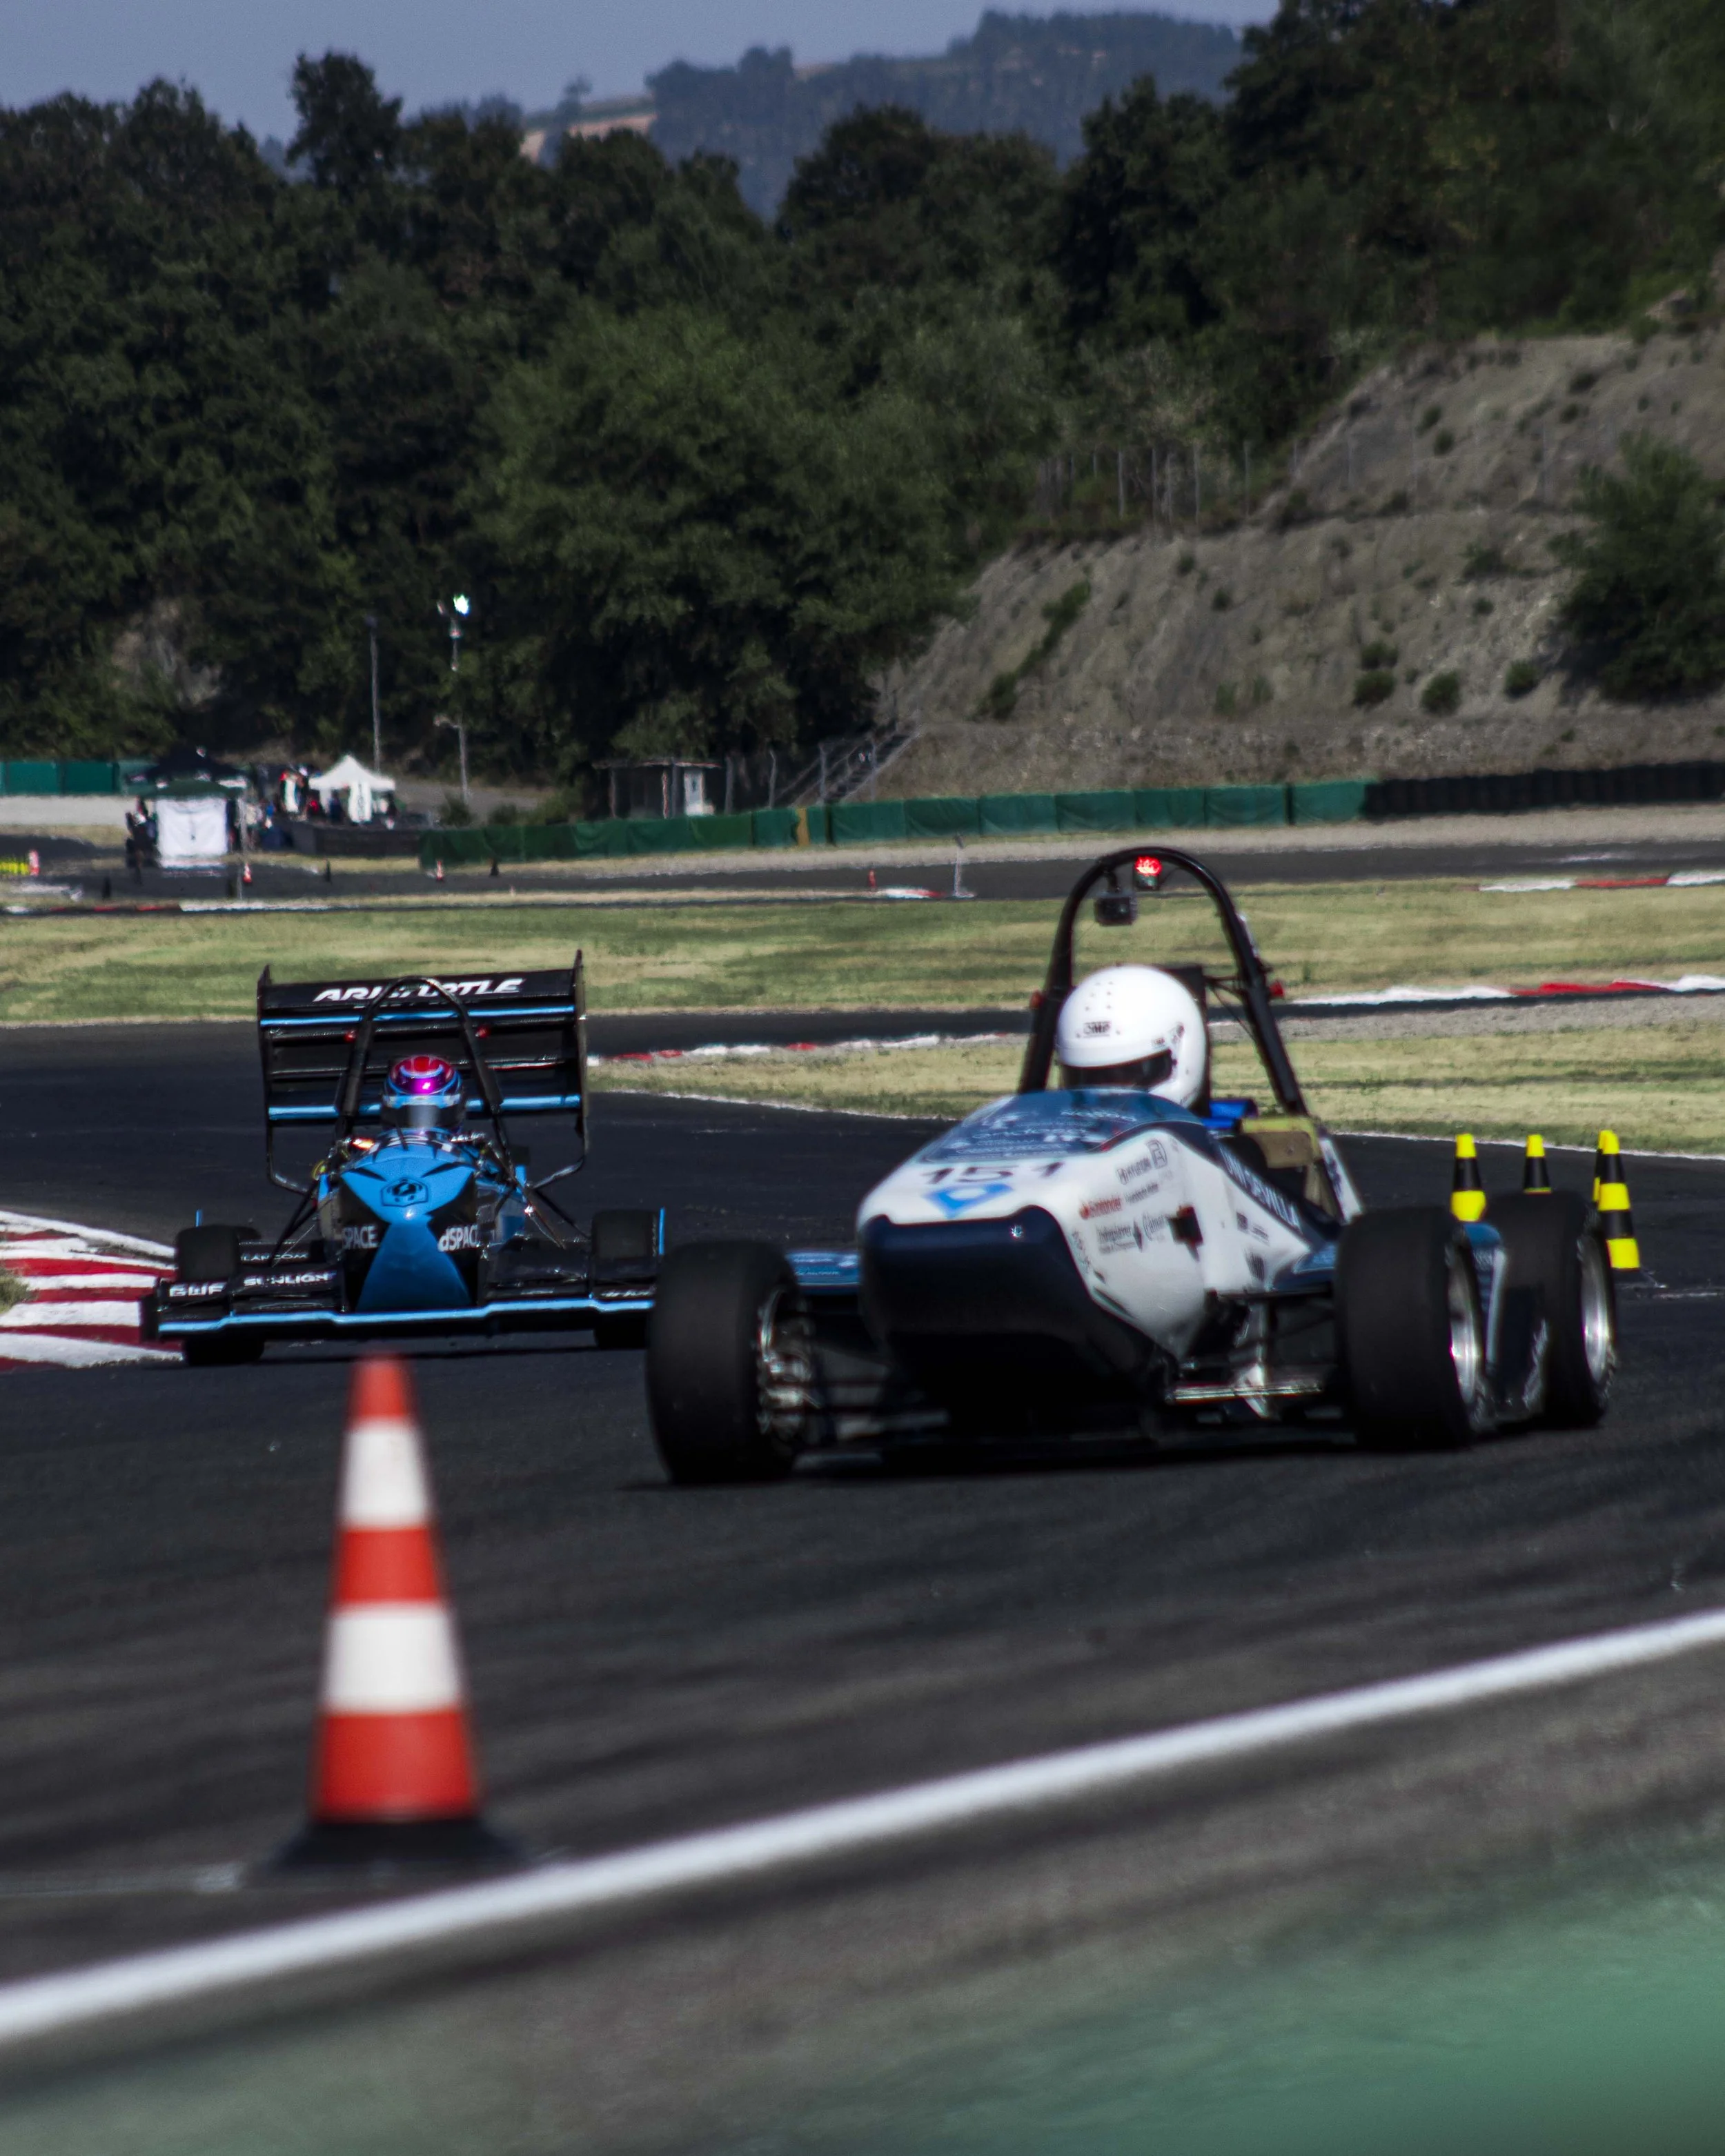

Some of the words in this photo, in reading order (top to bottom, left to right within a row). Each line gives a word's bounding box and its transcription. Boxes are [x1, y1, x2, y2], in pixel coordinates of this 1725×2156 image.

[312, 978, 526, 1002] ARIURTLE
[342, 1225, 379, 1249] SPACE
[437, 1225, 481, 1252] dSPAC
